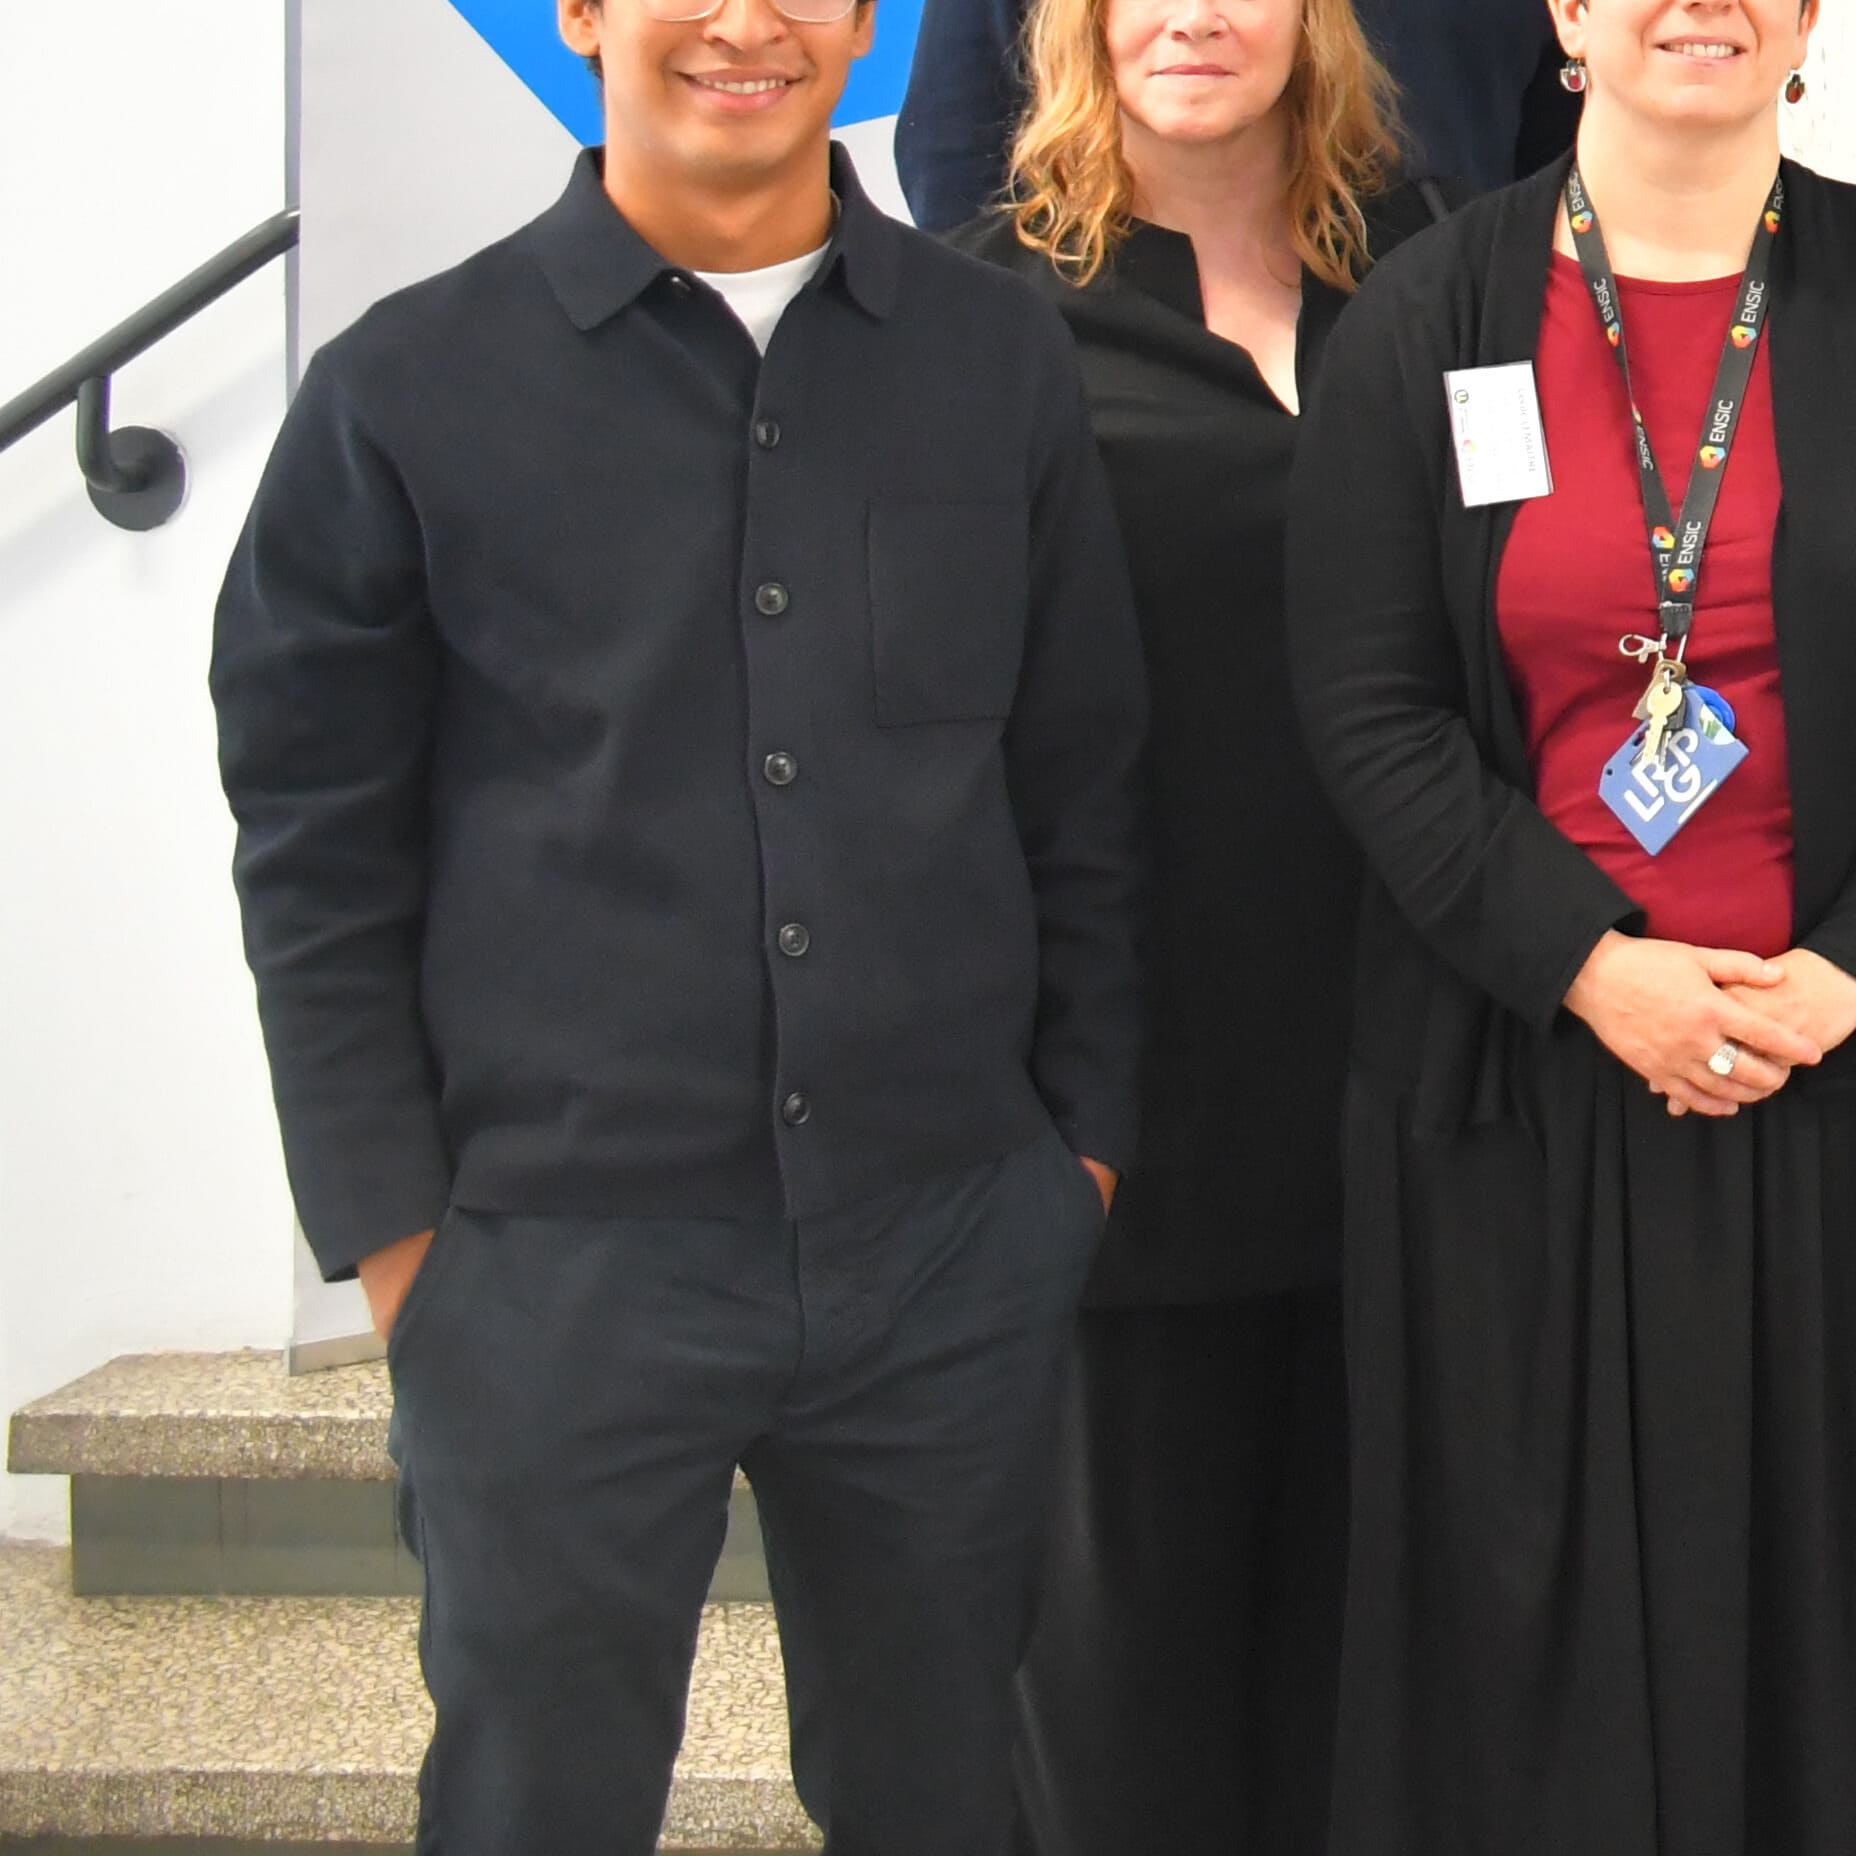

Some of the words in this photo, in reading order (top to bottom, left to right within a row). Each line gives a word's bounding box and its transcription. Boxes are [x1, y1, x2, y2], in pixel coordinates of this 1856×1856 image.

[1593, 278, 1615, 323] ENSIC
[1741, 280, 1765, 323] ENSIC
[1709, 399, 1734, 443] ENSIC
[1678, 521, 1702, 565] ENSIC
